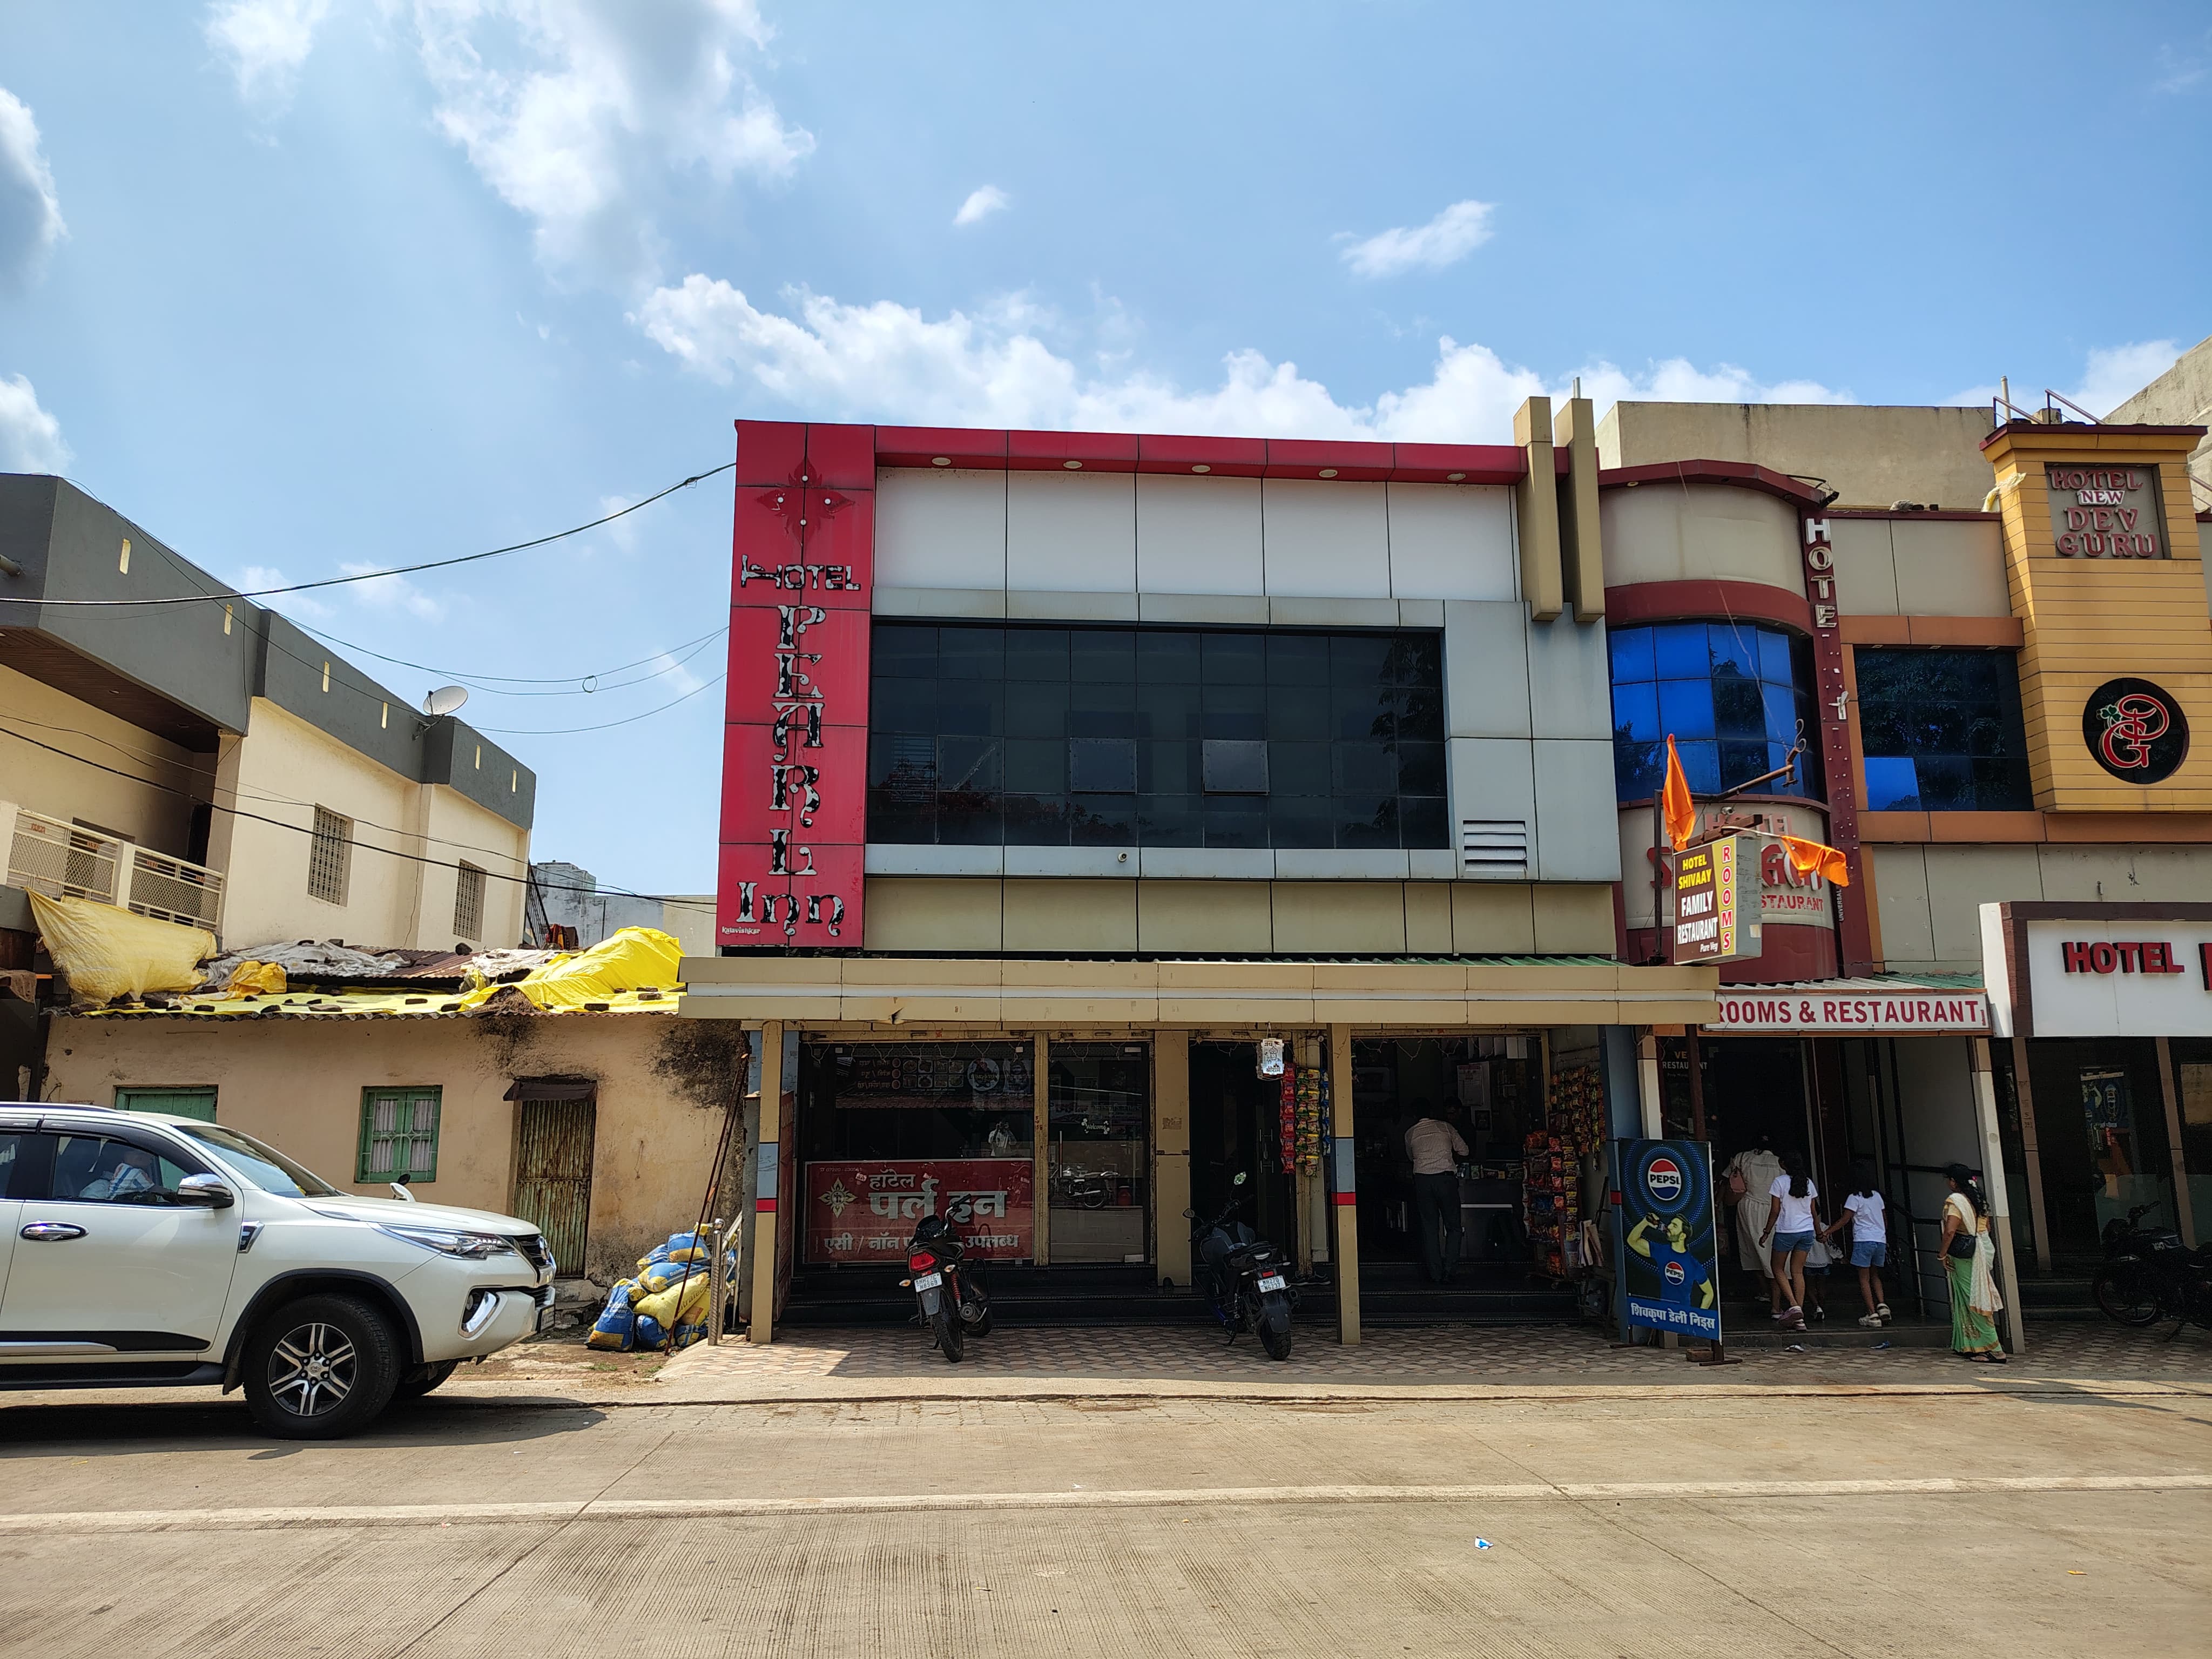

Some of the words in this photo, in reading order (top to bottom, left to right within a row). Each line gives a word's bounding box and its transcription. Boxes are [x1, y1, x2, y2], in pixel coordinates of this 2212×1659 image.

[2048, 469, 2143, 490] HOTEL
[2077, 490, 2126, 505] NEW
[2064, 507, 2139, 532] DEV
[2057, 532, 2157, 557] GURU
[741, 554, 861, 591] HOTEL
[768, 605, 826, 875] PEARL
[1682, 854, 1707, 871] HOTEL
[1678, 868, 1712, 890] SHIVAAY
[736, 881, 845, 936] Inn
[1681, 891, 1714, 917] FAMILY
[1721, 845, 1733, 950] ROOMS
[1836, 889, 1844, 921] UNIVERSAL
[1677, 916, 1718, 945] RESTAURANT
[1700, 943, 1710, 952] Pure
[1710, 942, 1718, 952] Veg
[2061, 942, 2185, 973] HOTEL
[1799, 1001, 1816, 1023] &
[1823, 1001, 1979, 1023] RESTAURANT
[1662, 1061, 1708, 1070] RESTAUNT
[1674, 1051, 1688, 1059] VE
[868, 1168, 916, 1191] हॉटेल
[1650, 1174, 1681, 1185] PEPSI
[868, 1178, 940, 1219] पर्ल
[824, 1232, 853, 1253] एसी
[868, 1232, 899, 1251] नॉन
[1666, 1268, 1683, 1278] PEPSI
[1630, 1302, 1667, 1323] शिवकृपा
[1668, 1308, 1688, 1325] डेली
